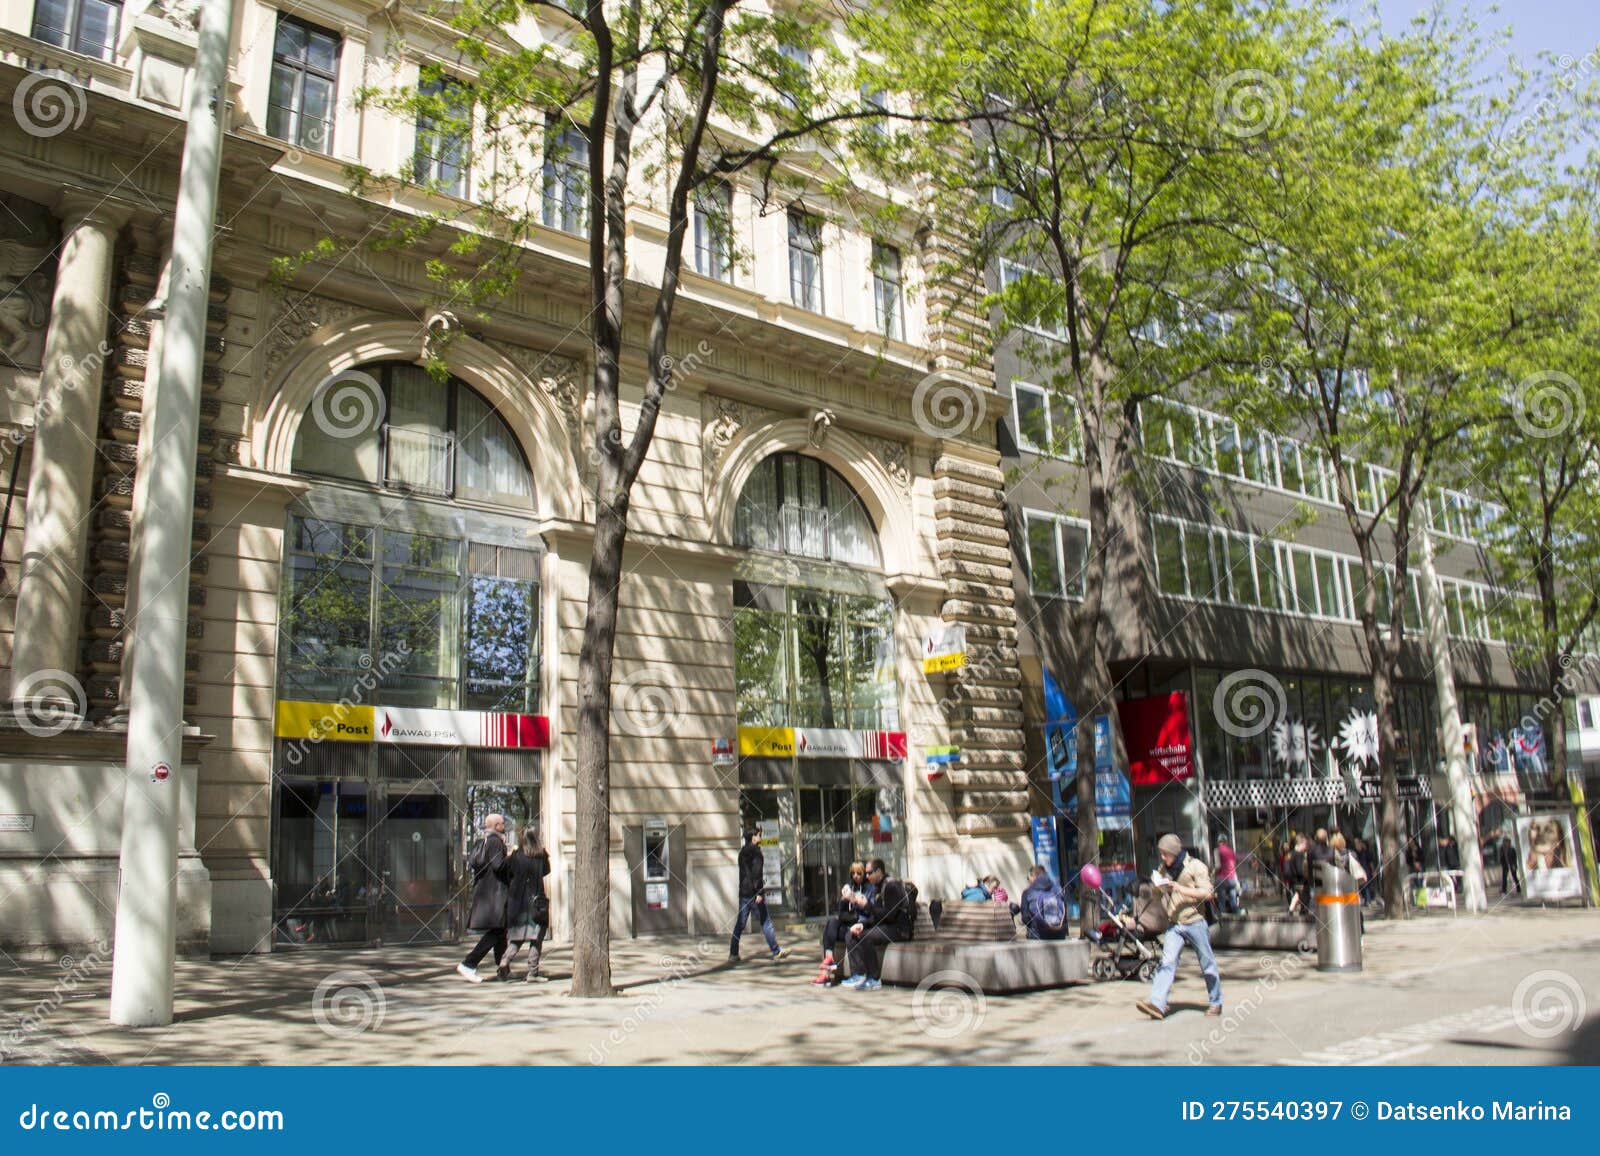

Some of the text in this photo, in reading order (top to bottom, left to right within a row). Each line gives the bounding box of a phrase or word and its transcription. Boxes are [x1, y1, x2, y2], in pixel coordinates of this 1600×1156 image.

[336, 723, 370, 735] Post
[391, 728, 432, 738] BAWAG
[771, 742, 793, 751] Post
